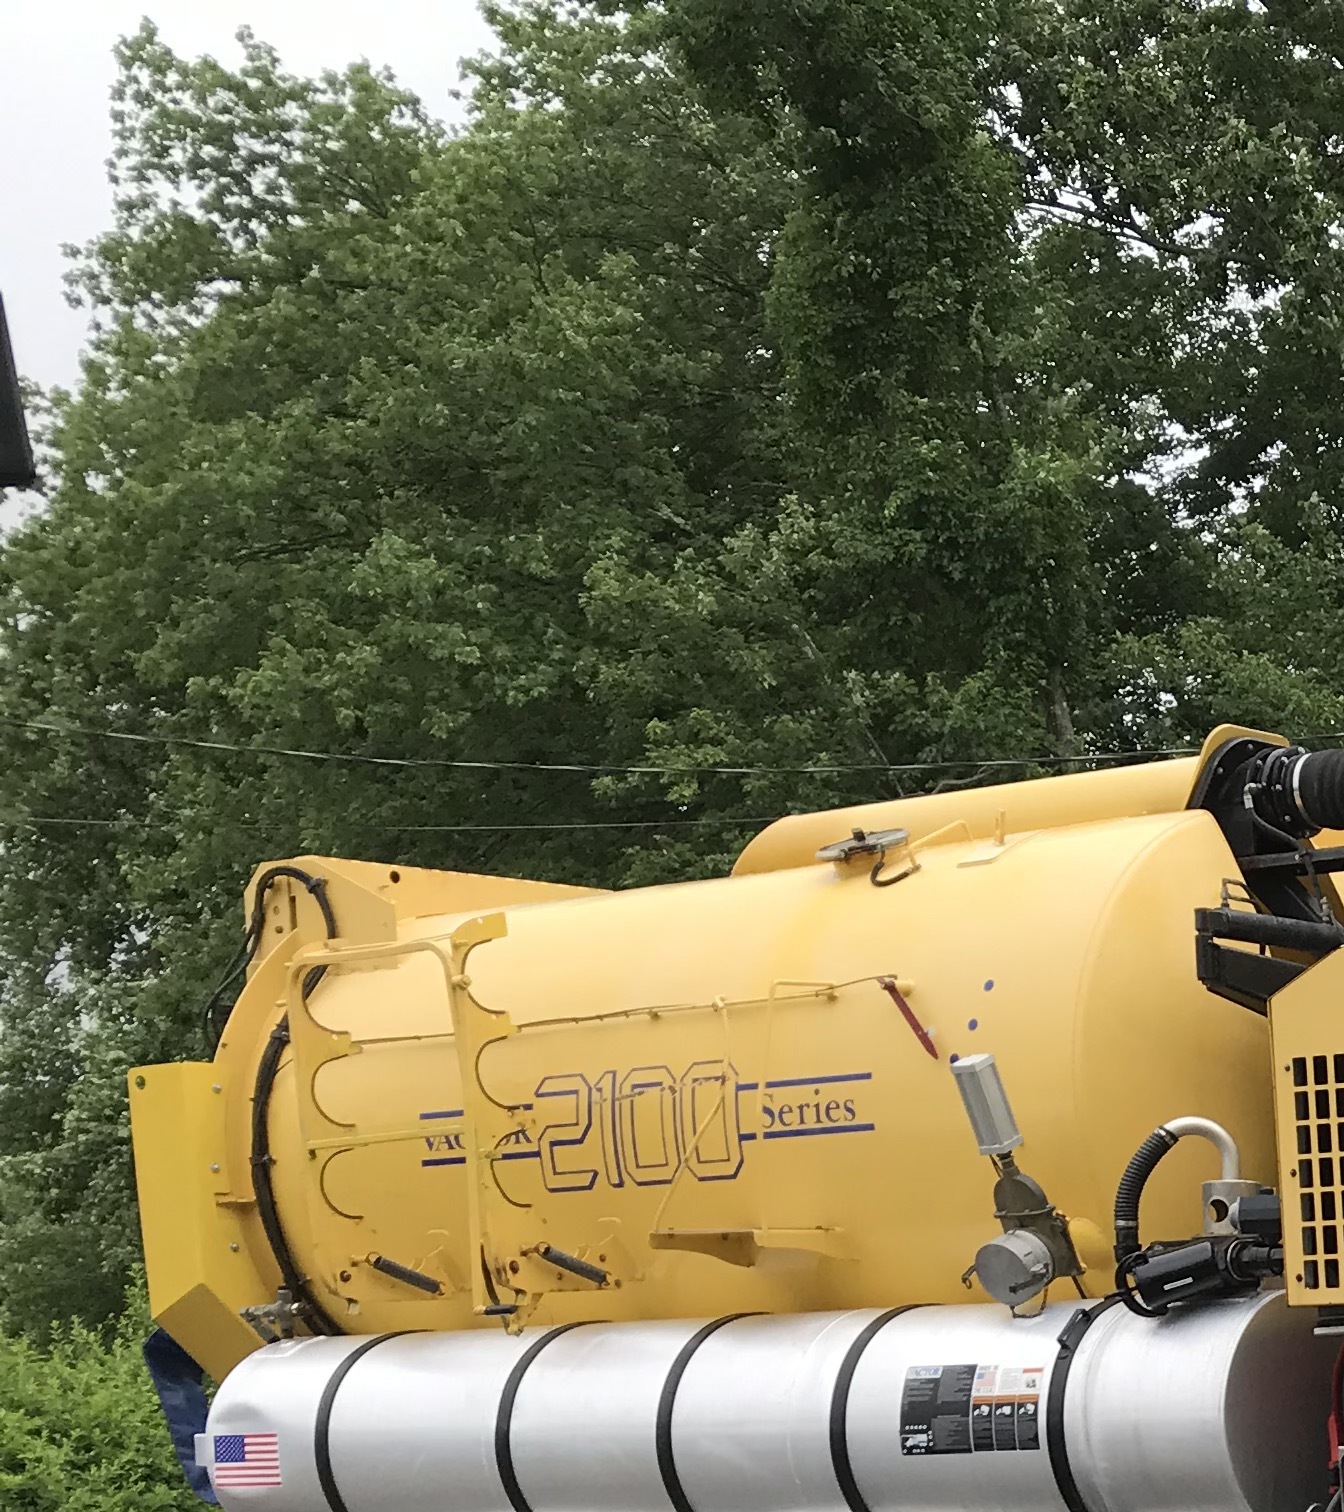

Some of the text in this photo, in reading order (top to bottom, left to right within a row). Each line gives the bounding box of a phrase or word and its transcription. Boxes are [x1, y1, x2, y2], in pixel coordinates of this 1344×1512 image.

[424, 1059, 857, 1193] VACR 2100 Series
